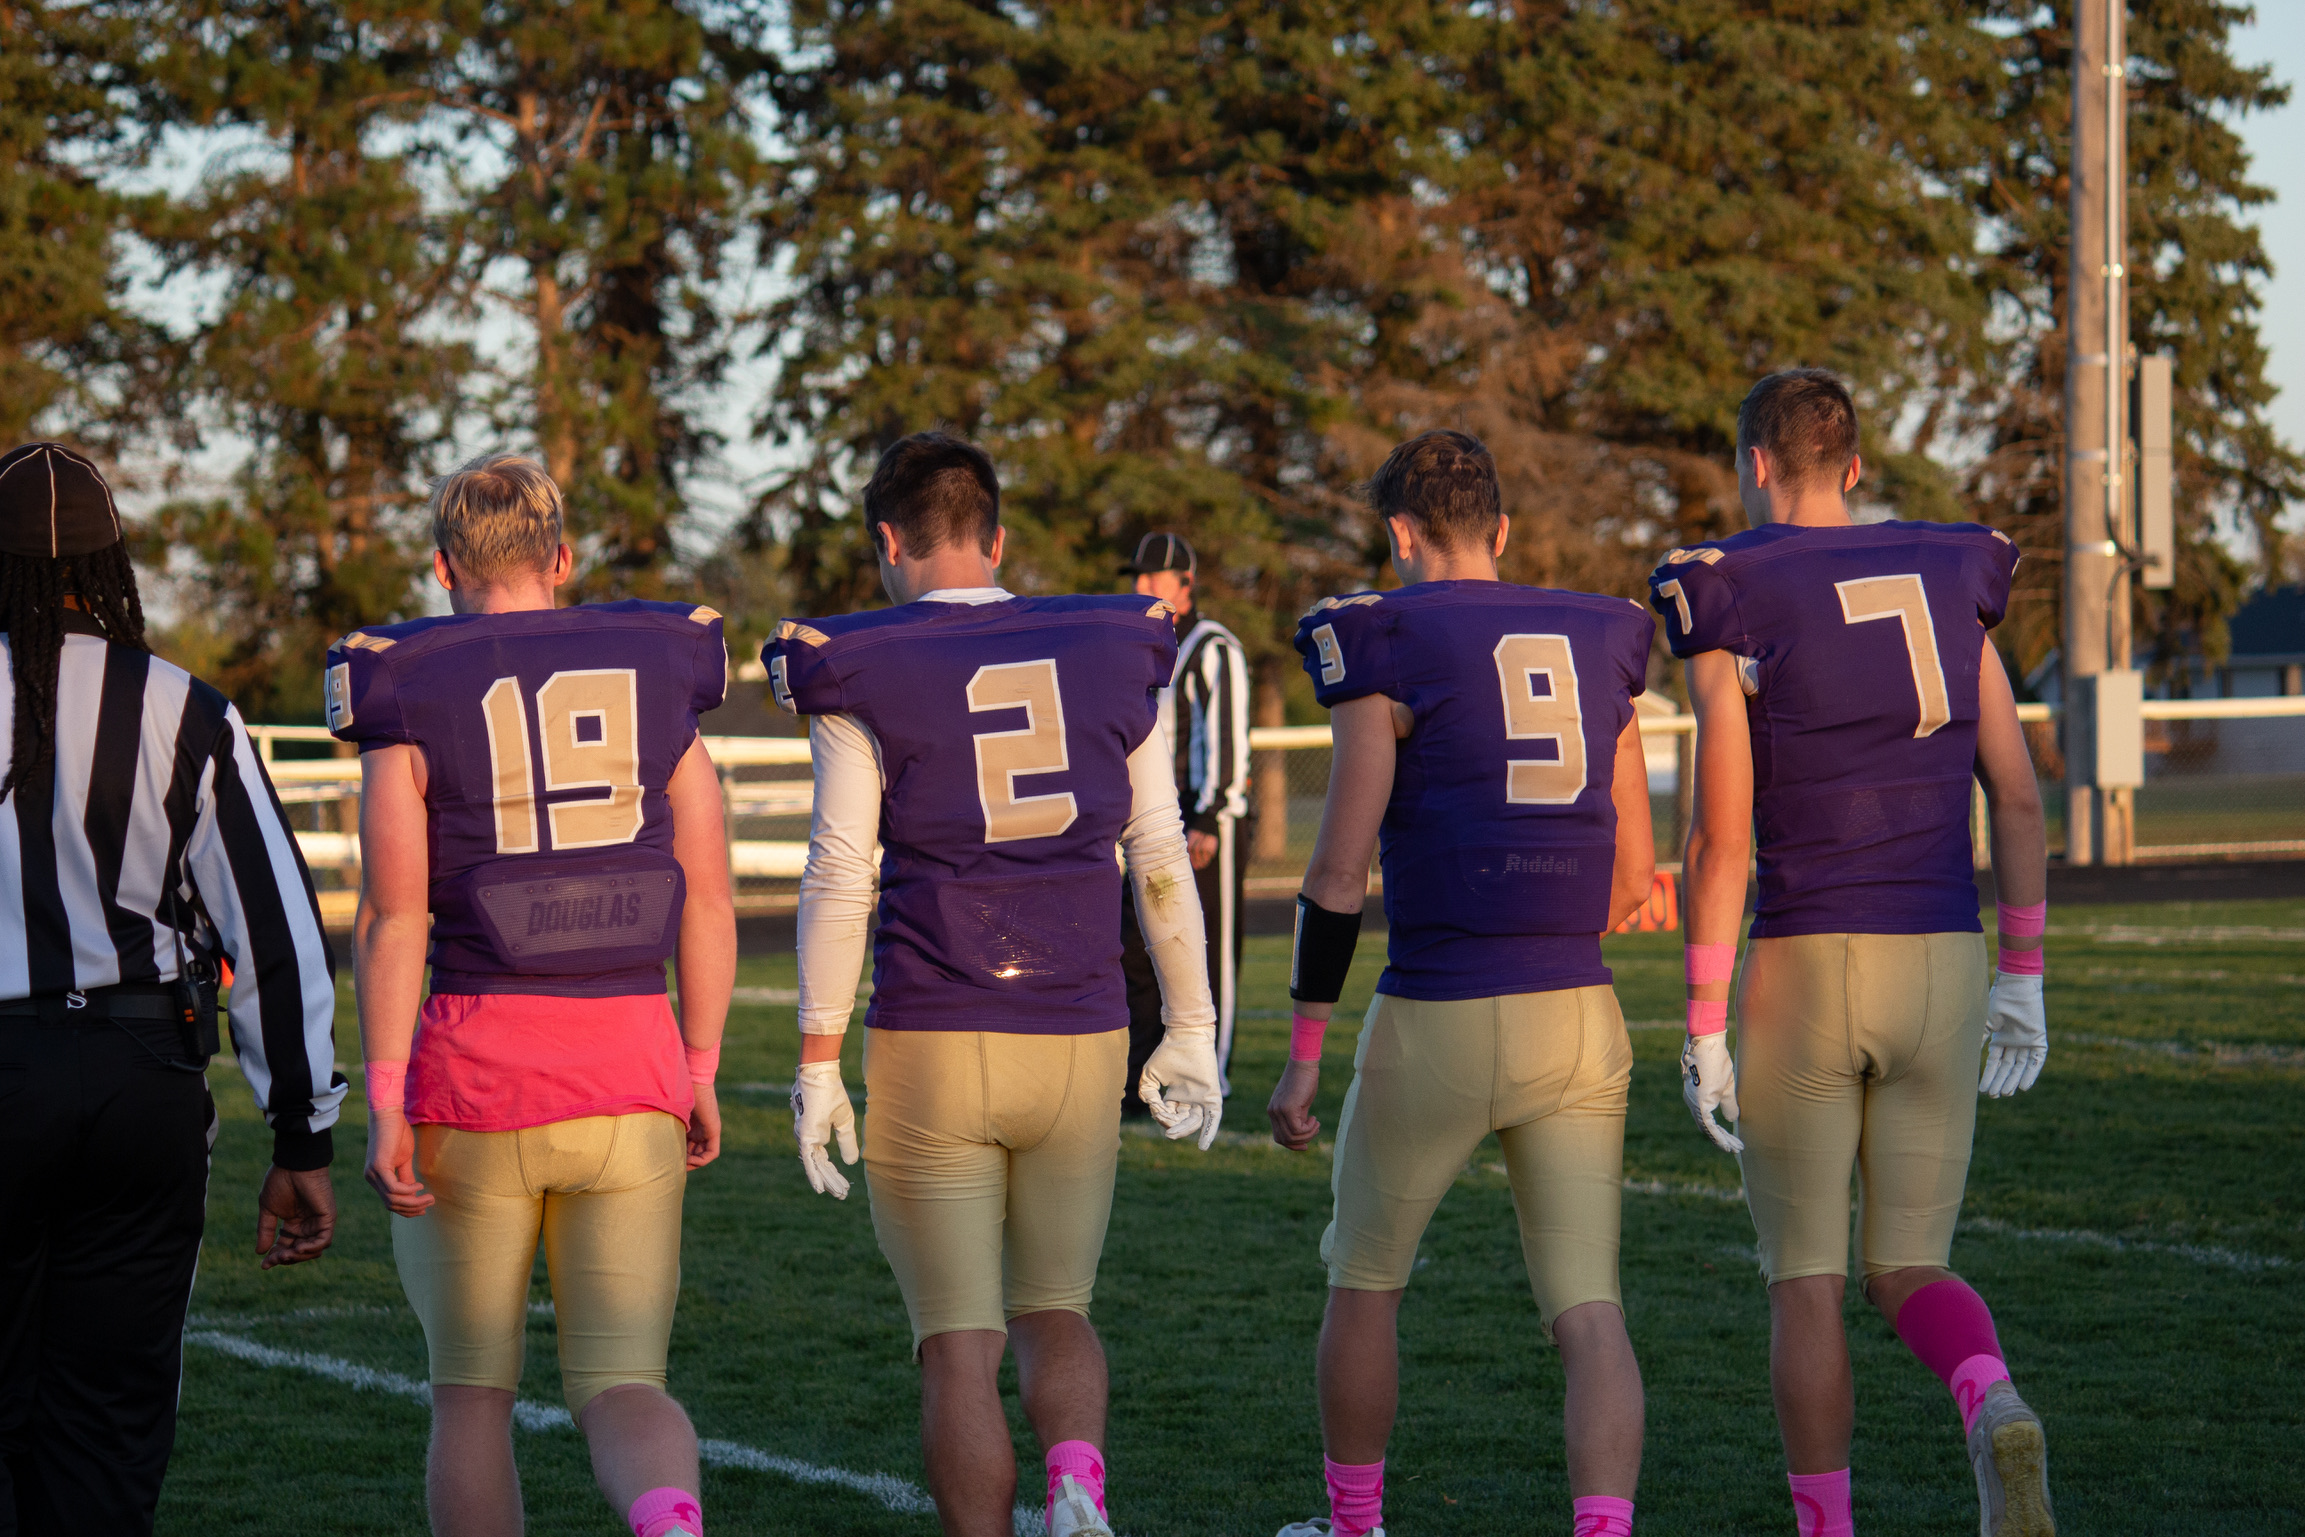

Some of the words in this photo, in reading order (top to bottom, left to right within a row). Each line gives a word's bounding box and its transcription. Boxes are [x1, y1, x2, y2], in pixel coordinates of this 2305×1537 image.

[1657, 578, 1693, 635] 7
[771, 655, 797, 715] 2
[1312, 623, 1346, 686] 9
[1834, 573, 1950, 739] 7
[1492, 633, 1587, 804] 9
[481, 668, 645, 854] 19
[965, 658, 1078, 844] 2
[1505, 853, 1579, 876] Riddell
[527, 892, 641, 936] DOUGLAS
